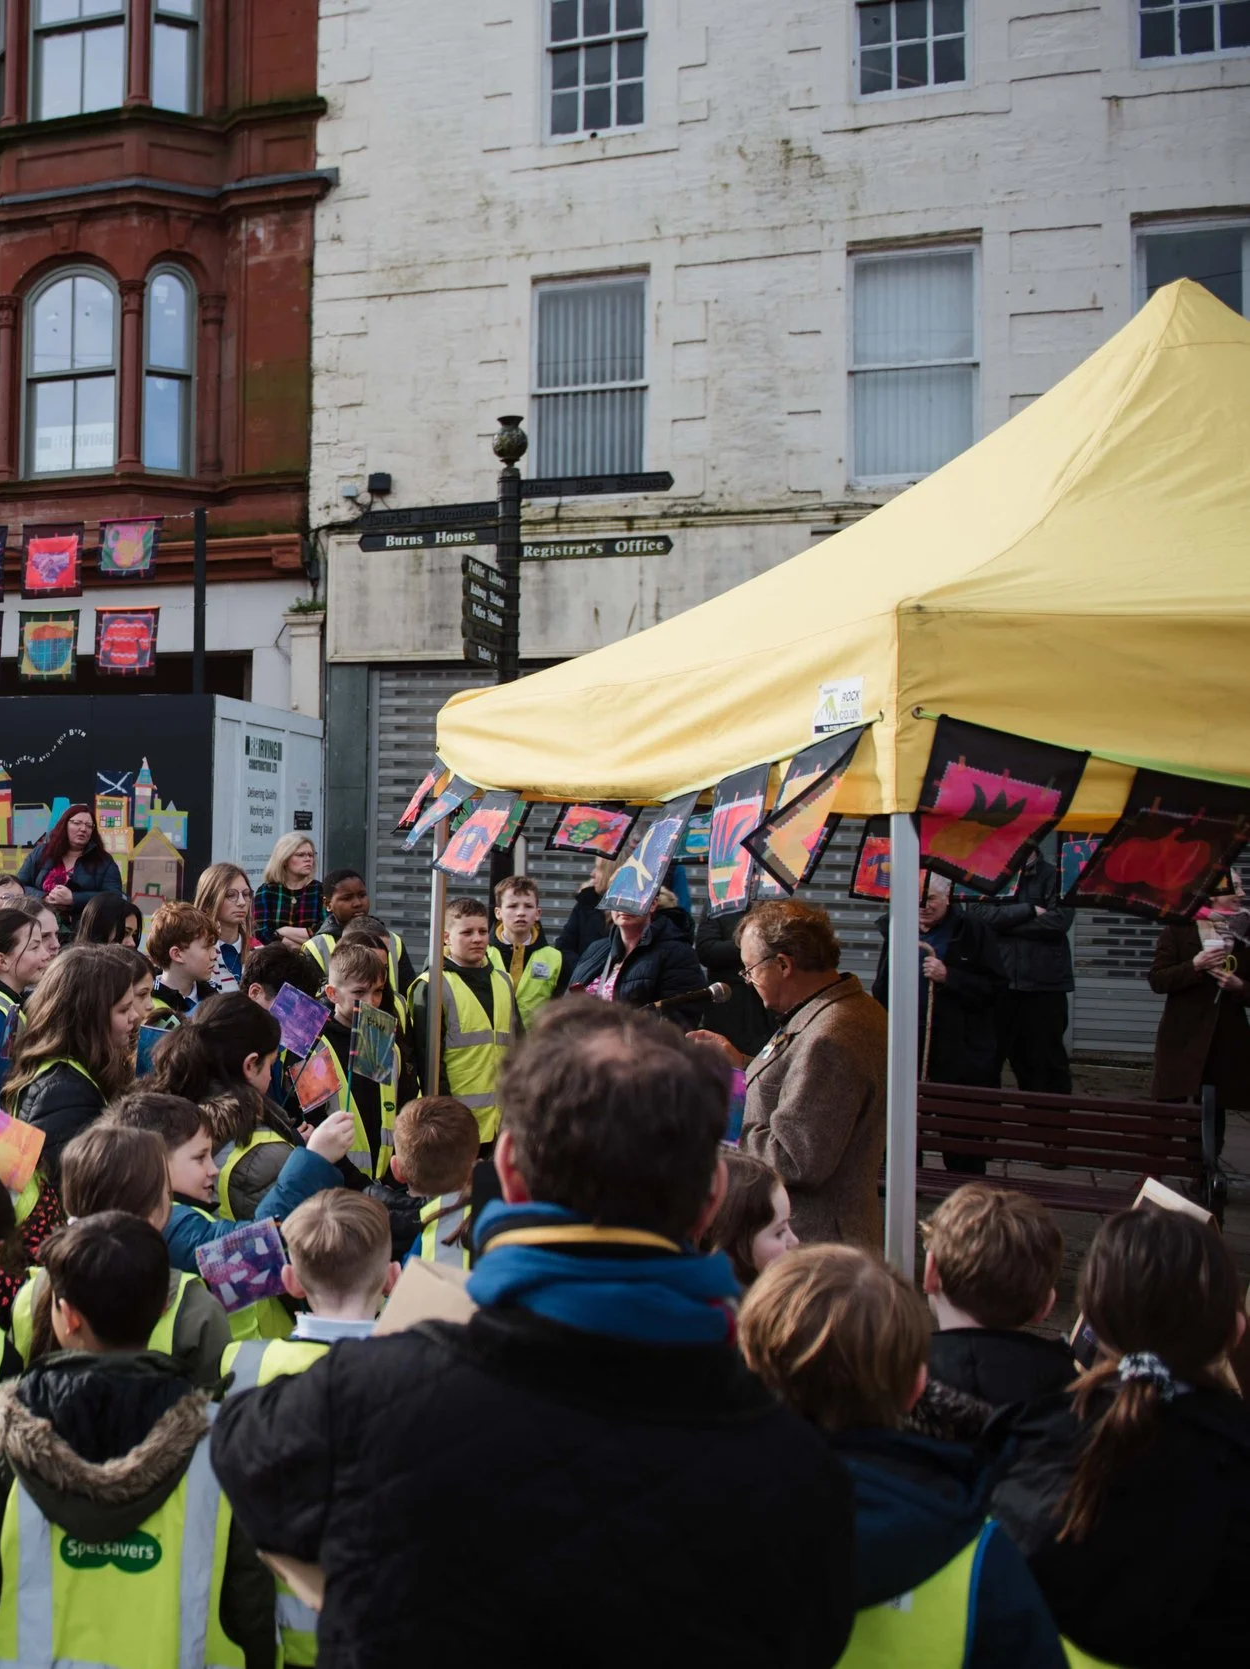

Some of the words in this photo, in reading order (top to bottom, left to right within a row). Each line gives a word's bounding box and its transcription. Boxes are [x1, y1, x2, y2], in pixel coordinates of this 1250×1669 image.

[385, 535, 423, 547] Burns
[435, 531, 476, 544] House
[522, 543, 604, 558] Registrar's
[614, 539, 664, 553] Office
